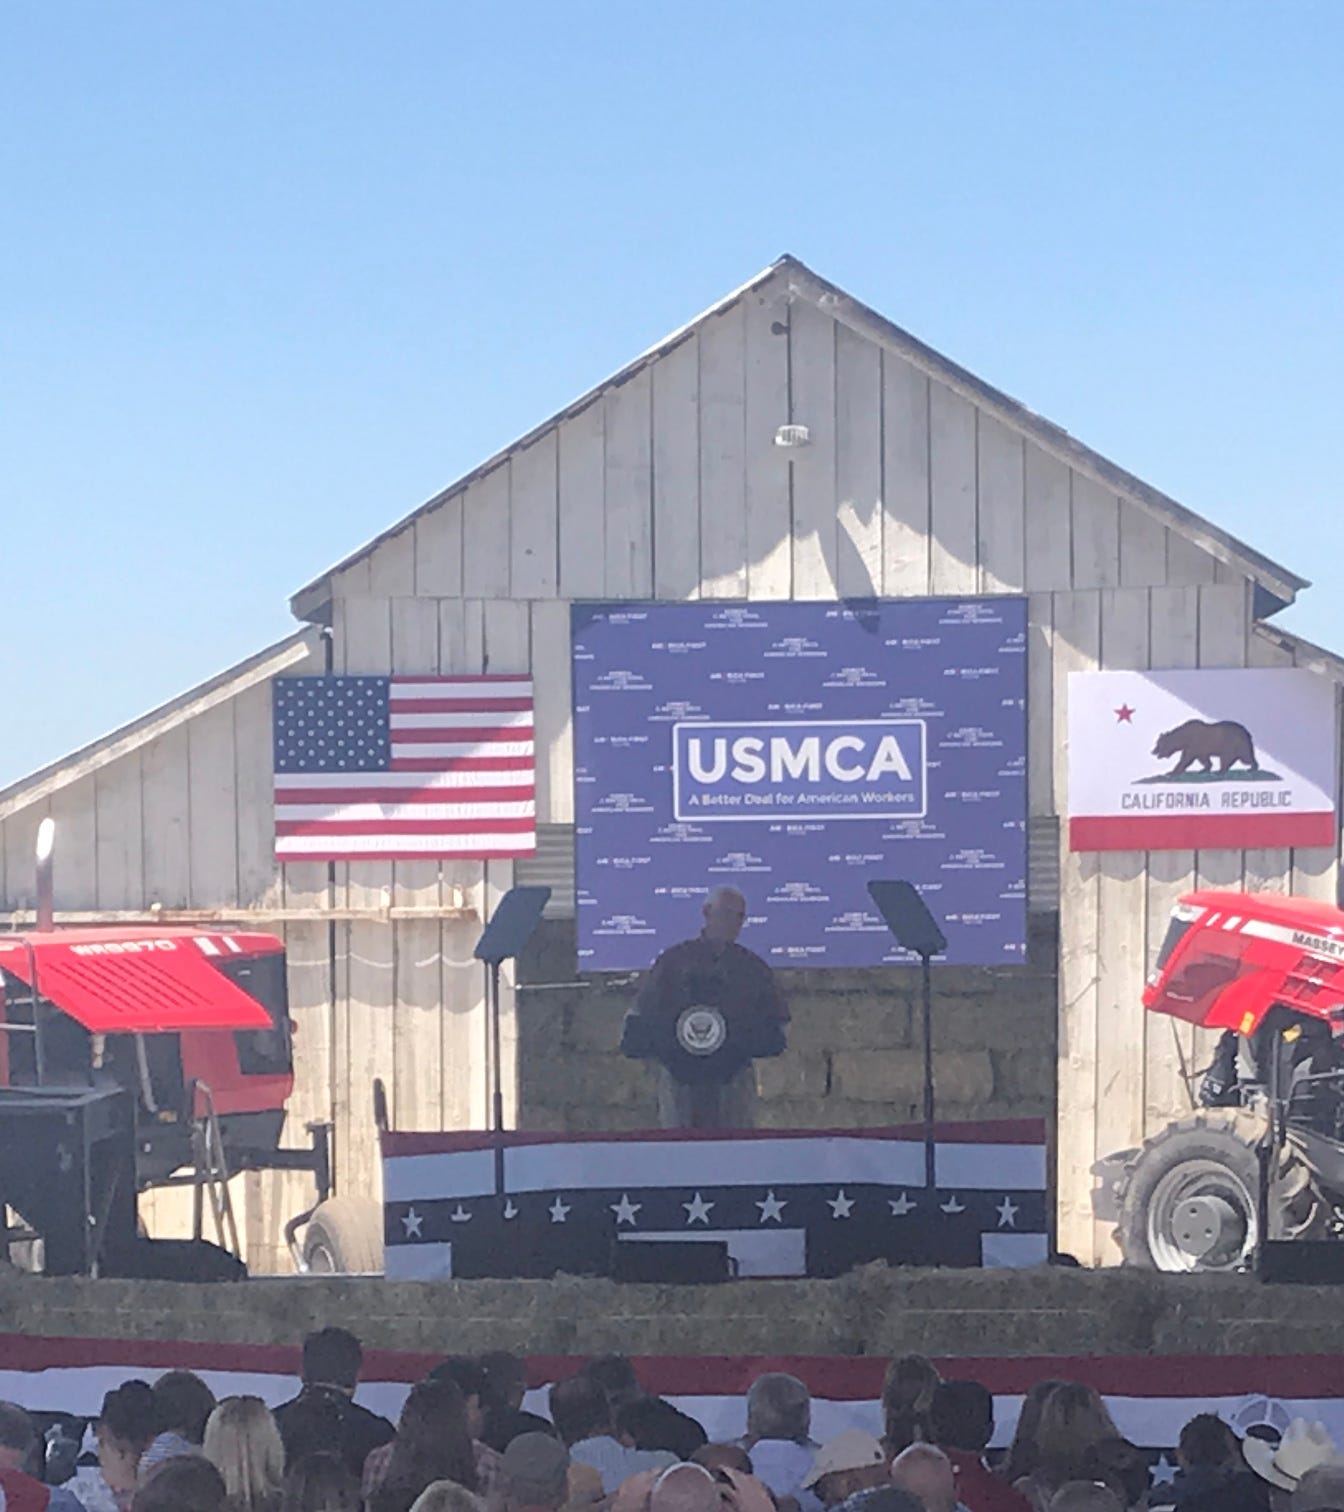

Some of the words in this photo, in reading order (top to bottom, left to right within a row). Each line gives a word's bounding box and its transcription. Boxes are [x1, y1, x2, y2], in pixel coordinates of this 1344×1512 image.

[688, 735, 913, 783] USMCA
[688, 795, 700, 805] A
[702, 794, 742, 805] Better
[744, 793, 773, 804] Deal
[775, 793, 795, 804] for
[797, 792, 859, 804] American
[861, 791, 914, 803] Workers
[1121, 793, 1210, 809] CALIFORNIA
[1221, 791, 1292, 808] REPUBLIC
